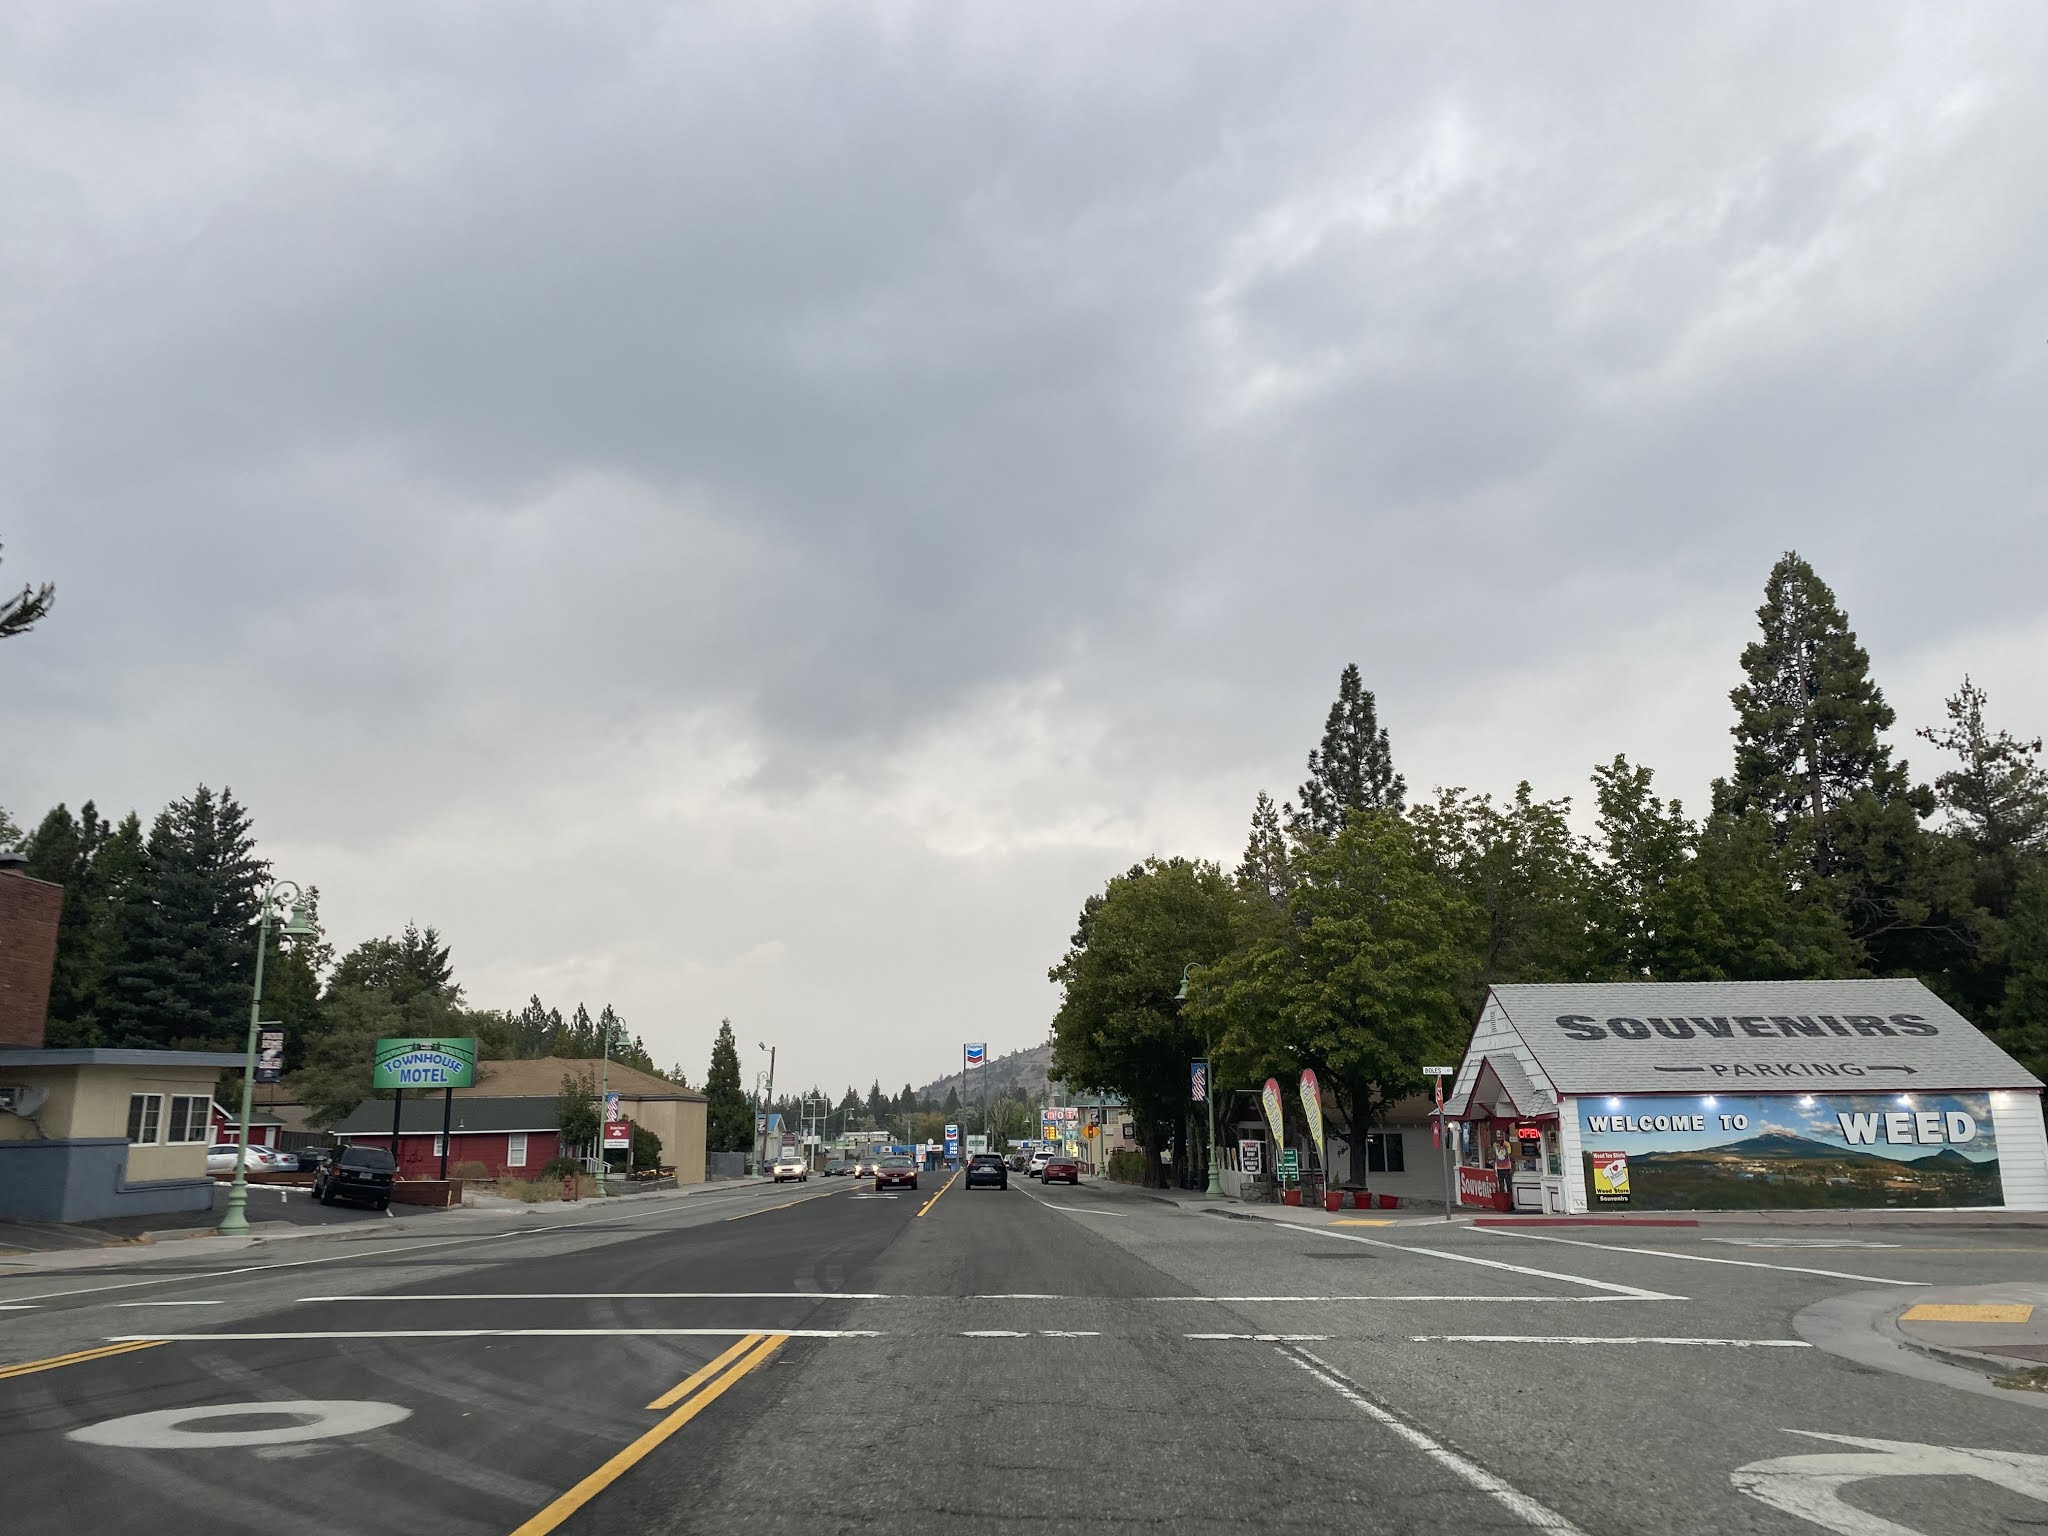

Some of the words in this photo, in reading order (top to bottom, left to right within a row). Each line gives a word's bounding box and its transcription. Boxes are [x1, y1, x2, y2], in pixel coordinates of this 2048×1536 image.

[1556, 1014, 1939, 1041] SOUVENIRS
[384, 1053, 462, 1073] TOWNHOUSE
[1710, 1063, 1866, 1077] PARKING
[400, 1068, 447, 1083] MOTEL
[1518, 1128, 1542, 1139] OPEN
[1587, 1114, 1706, 1133] WELCOME
[1719, 1114, 1749, 1131] TO
[1837, 1111, 1977, 1145] WEED
